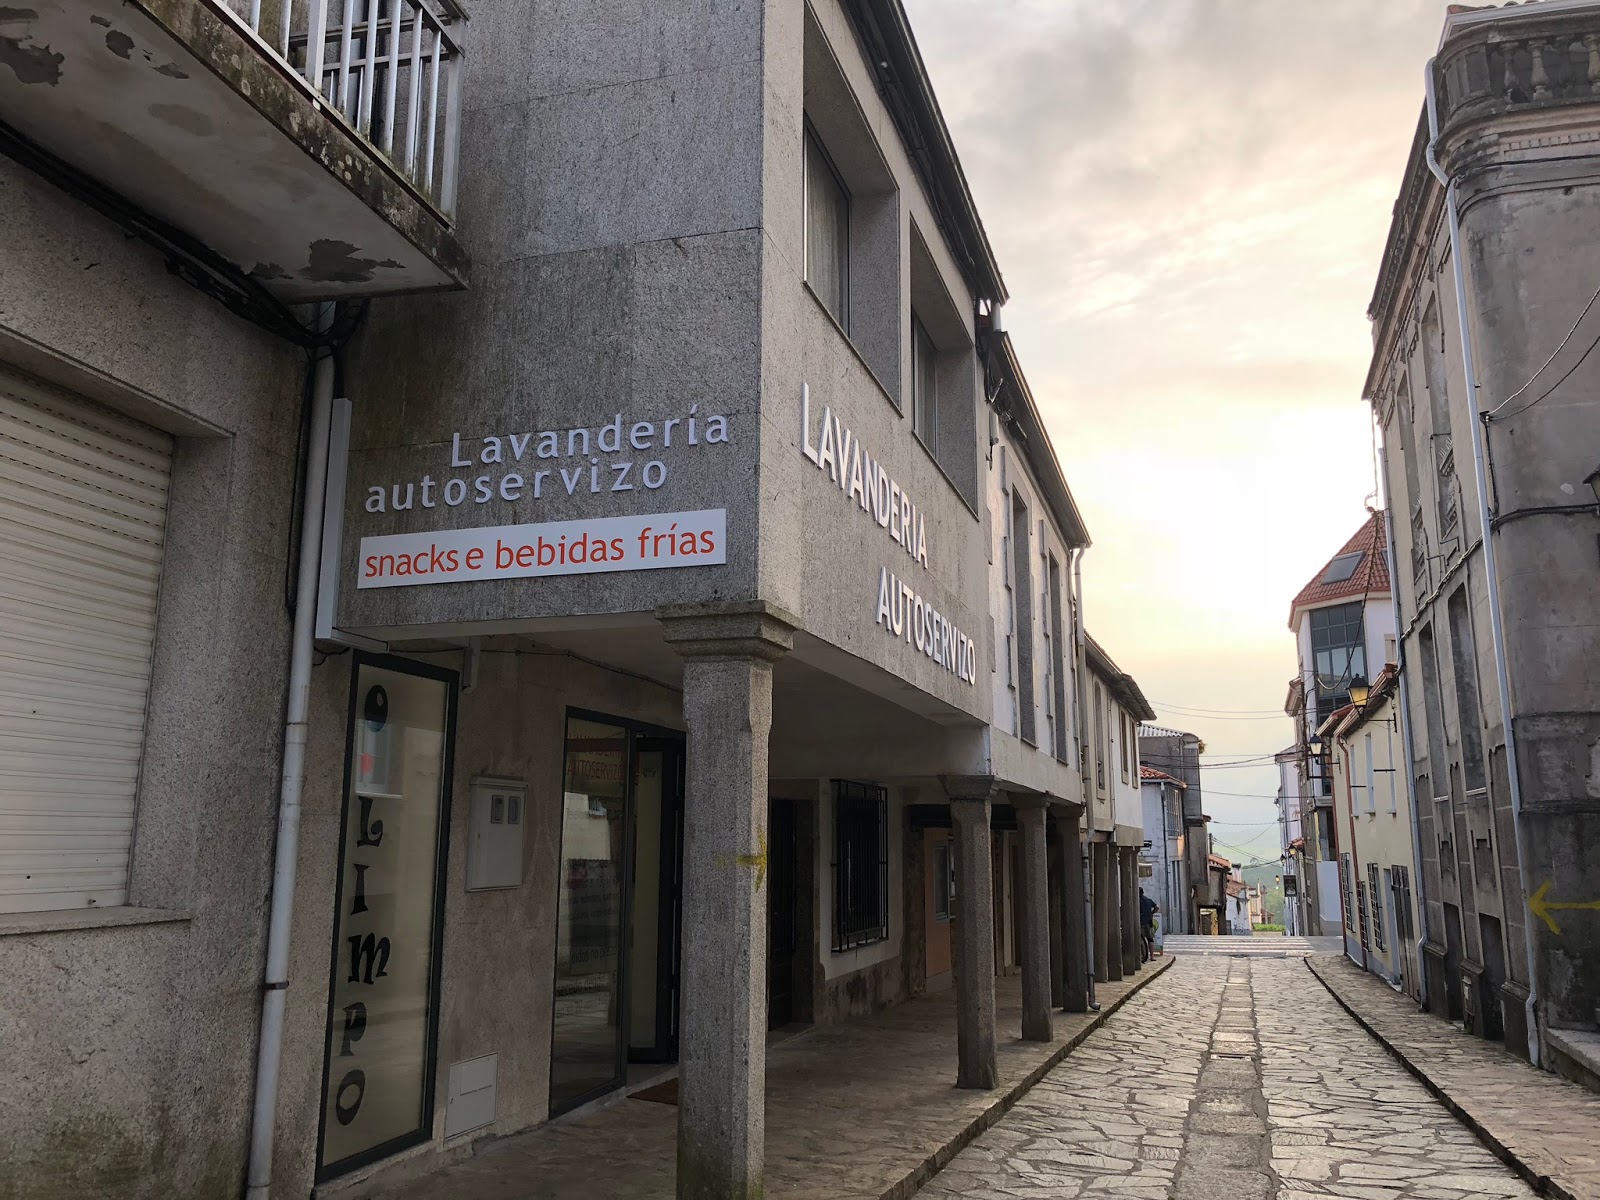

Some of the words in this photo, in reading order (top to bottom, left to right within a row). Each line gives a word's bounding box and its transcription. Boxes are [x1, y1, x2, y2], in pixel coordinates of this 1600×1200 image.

[450, 404, 729, 468] Lavandería
[364, 457, 668, 514] autoservizo
[801, 381, 928, 569] LAVANDERIA
[364, 543, 459, 578] snacks
[465, 546, 485, 571] e
[494, 532, 625, 570] bebidas
[637, 522, 716, 560] frías
[876, 566, 976, 685] AUTOSERVIZO
